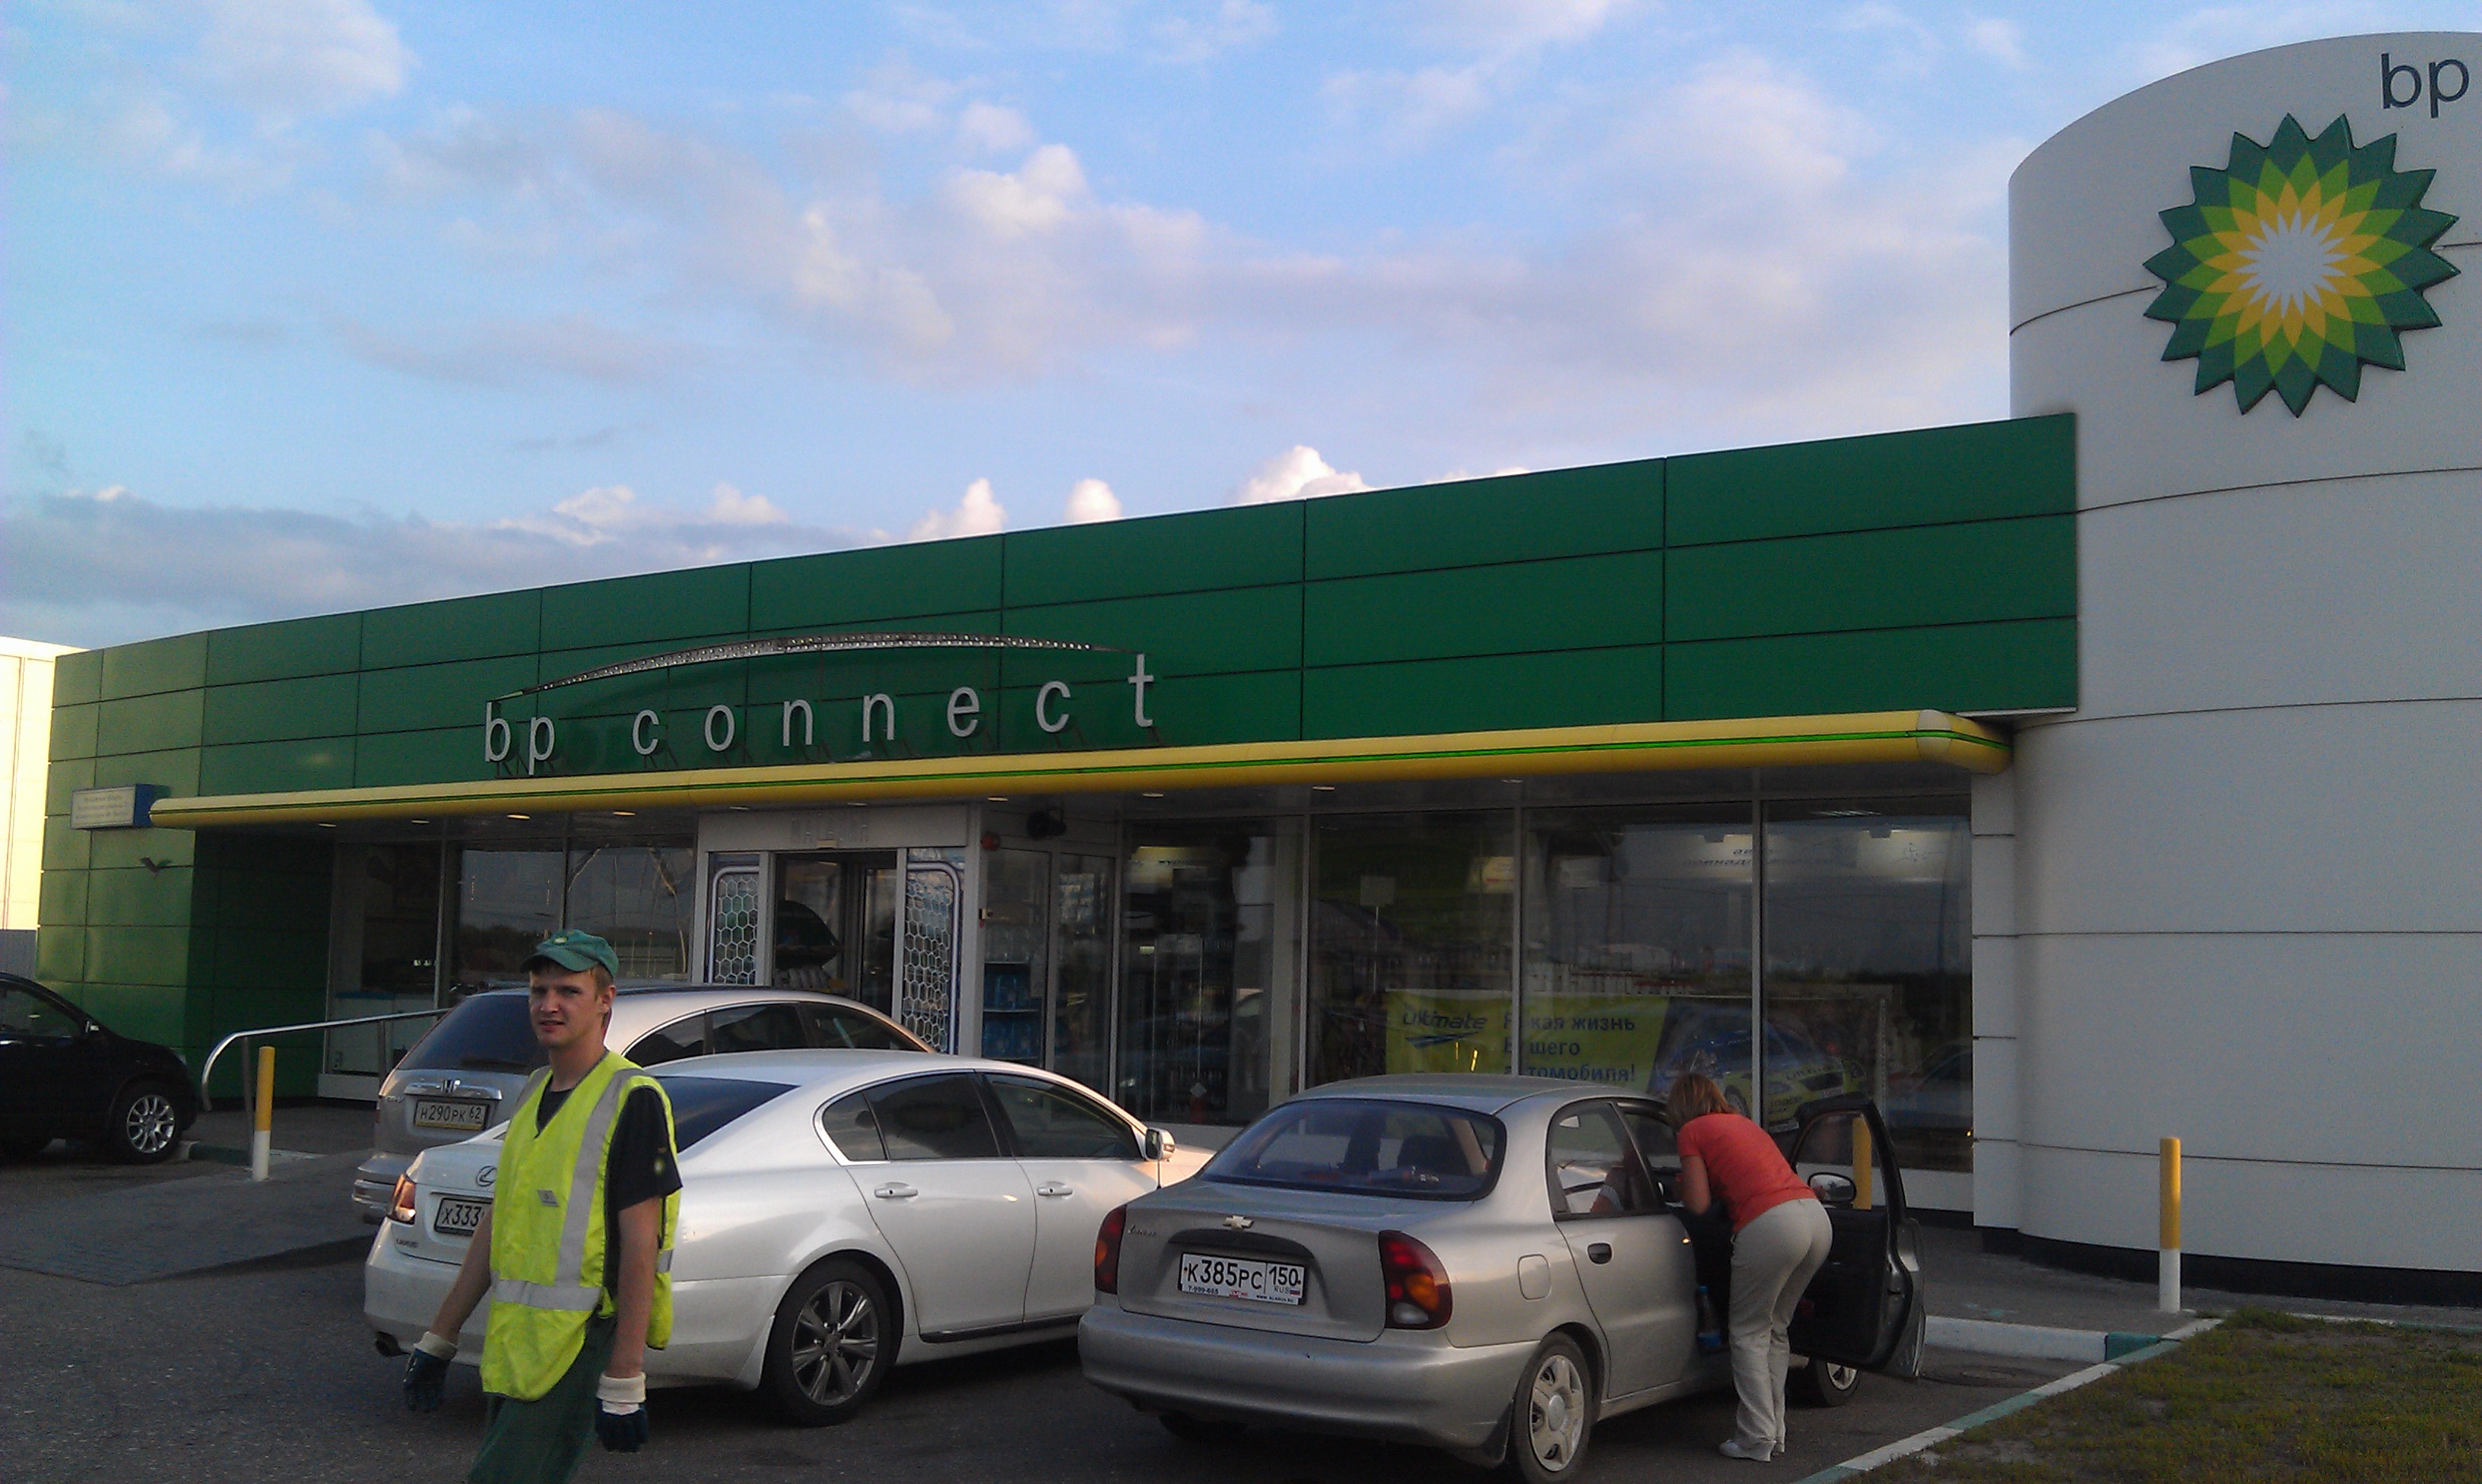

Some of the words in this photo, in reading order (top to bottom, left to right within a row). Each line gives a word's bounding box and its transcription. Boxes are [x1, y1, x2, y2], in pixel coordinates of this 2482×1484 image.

[2381, 52, 2469, 119] bp
[486, 701, 555, 775] bp
[632, 653, 1154, 756] connect
[1572, 1016, 1634, 1031] жизнь
[442, 1204, 484, 1227] Х333
[1268, 1266, 1298, 1286] 150
[1274, 1285, 1290, 1294] RUS
